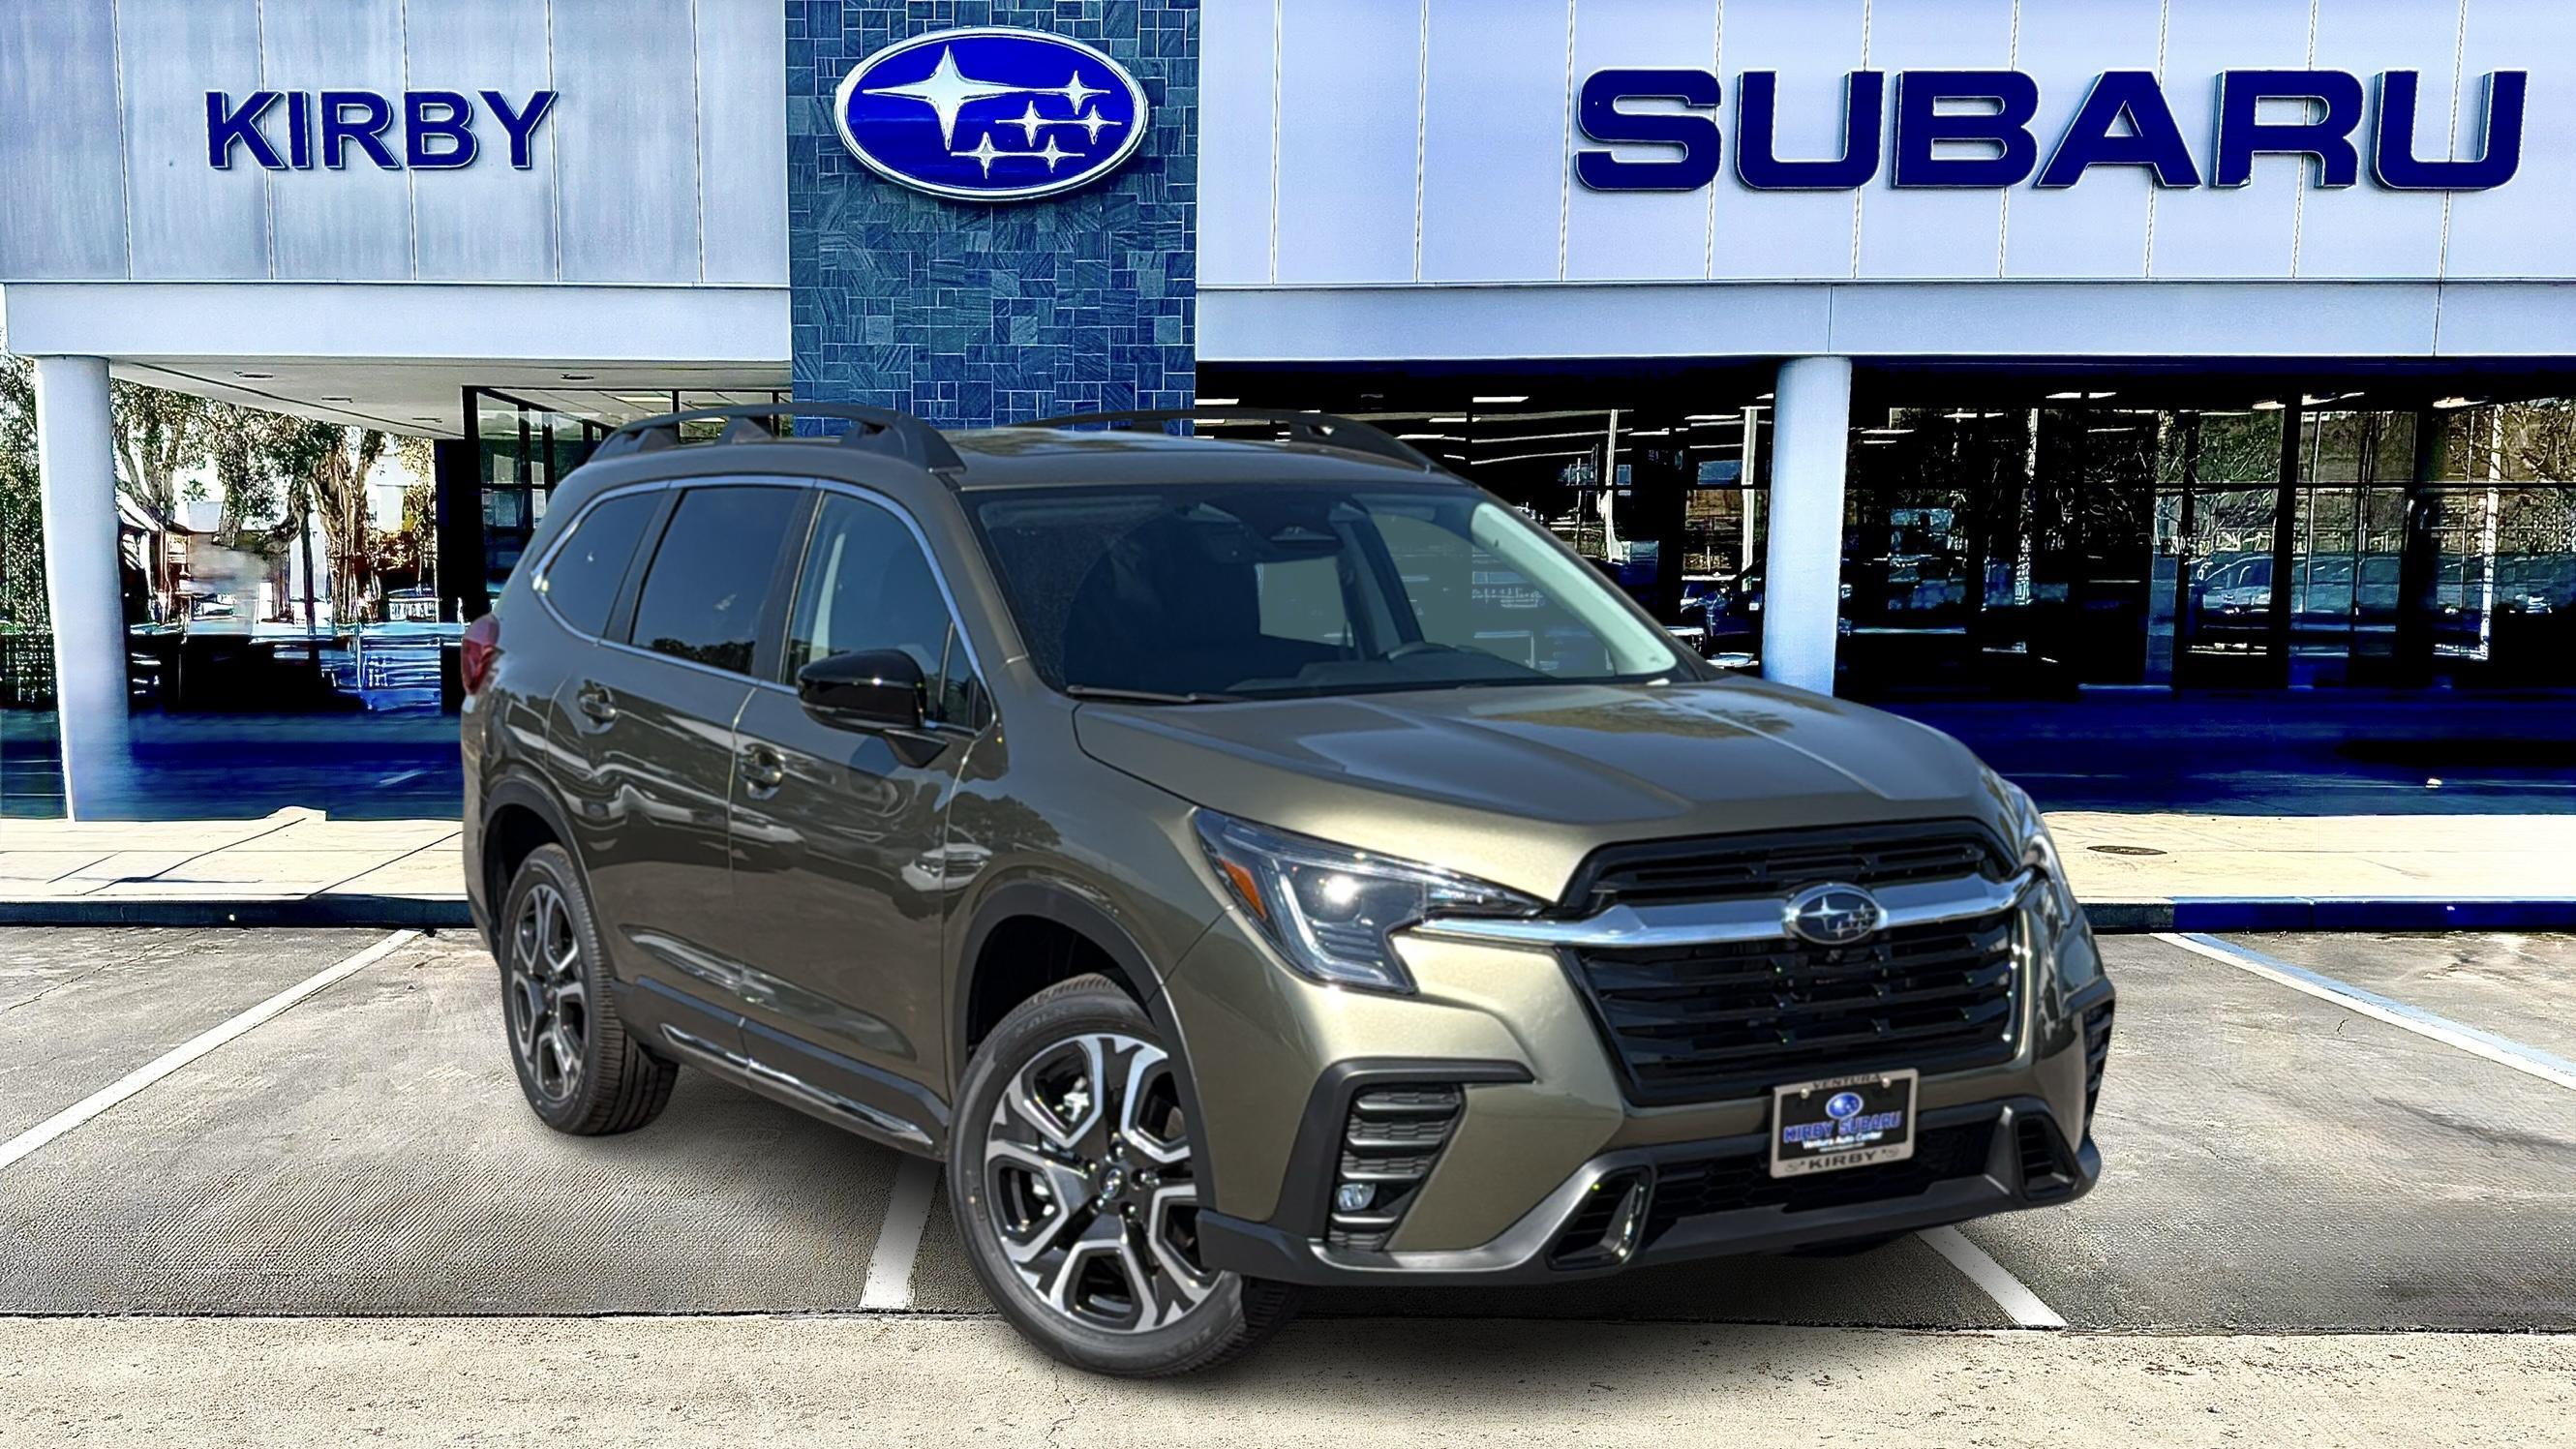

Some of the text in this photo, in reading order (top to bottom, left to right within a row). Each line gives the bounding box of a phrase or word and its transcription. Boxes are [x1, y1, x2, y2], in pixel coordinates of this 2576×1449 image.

[204, 90, 559, 170] KIRBY
[1574, 69, 2529, 192] SUBARU
[1812, 1073, 1882, 1089] VENTURA
[1783, 1110, 1902, 1144] KIRBY SUBARU
[1802, 1137, 1834, 1150] Ventura
[1808, 1150, 1877, 1169] KIRBY
